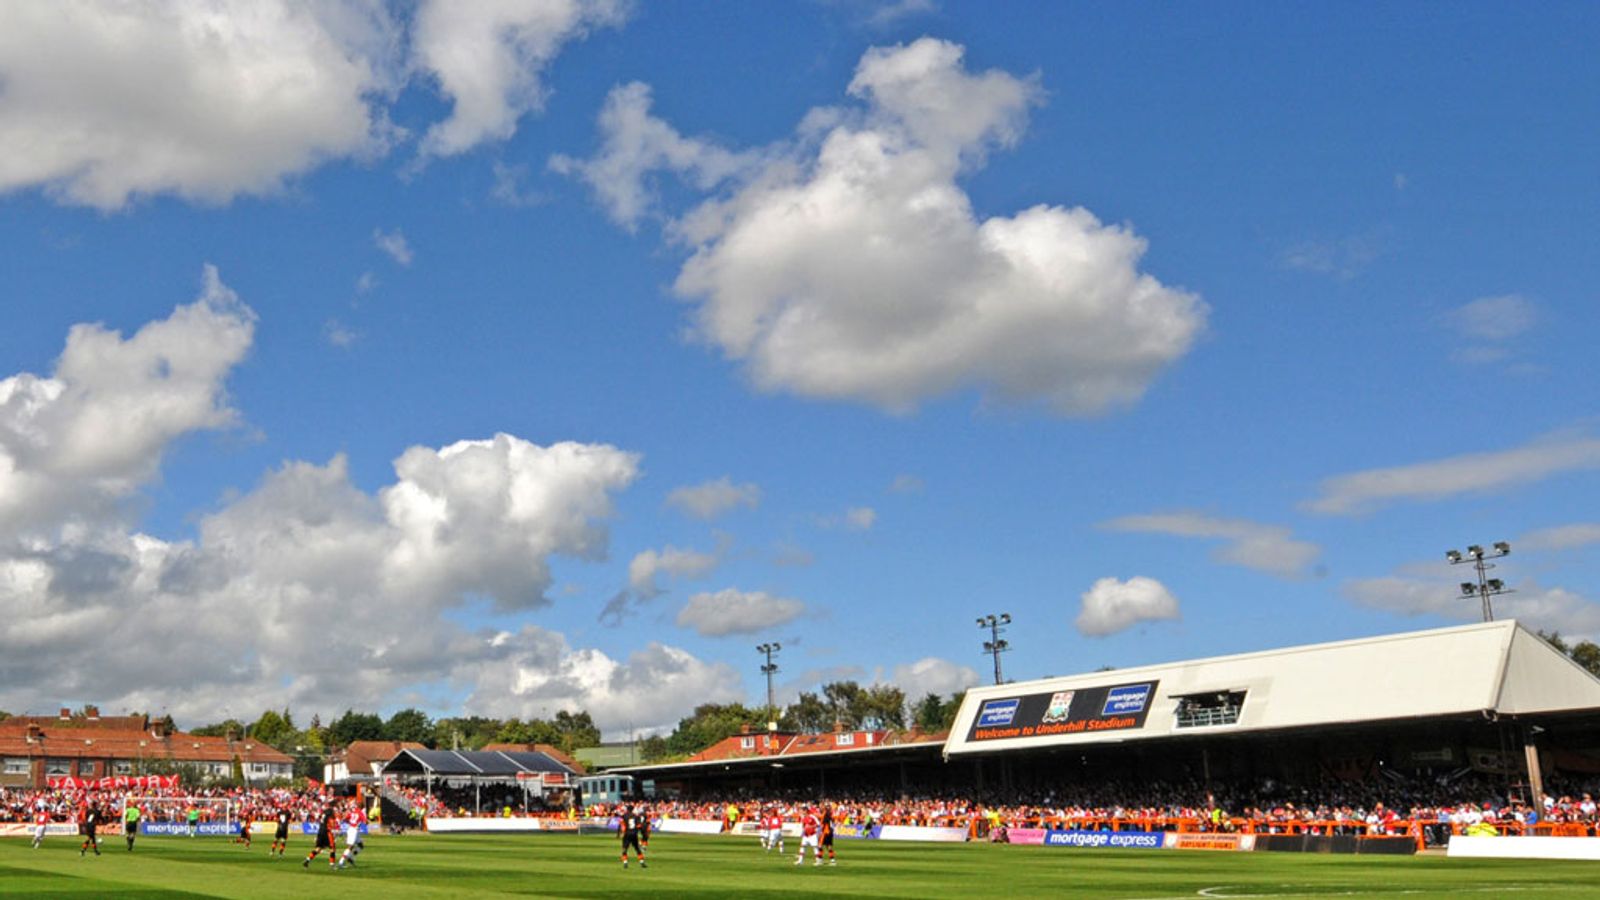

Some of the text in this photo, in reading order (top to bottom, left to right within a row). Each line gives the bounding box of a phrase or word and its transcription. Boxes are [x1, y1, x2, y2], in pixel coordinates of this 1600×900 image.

[975, 717, 1136, 739] Welcome to Underhill Stadium
[1050, 833, 1108, 846] mortgage
[1110, 834, 1157, 847] express
